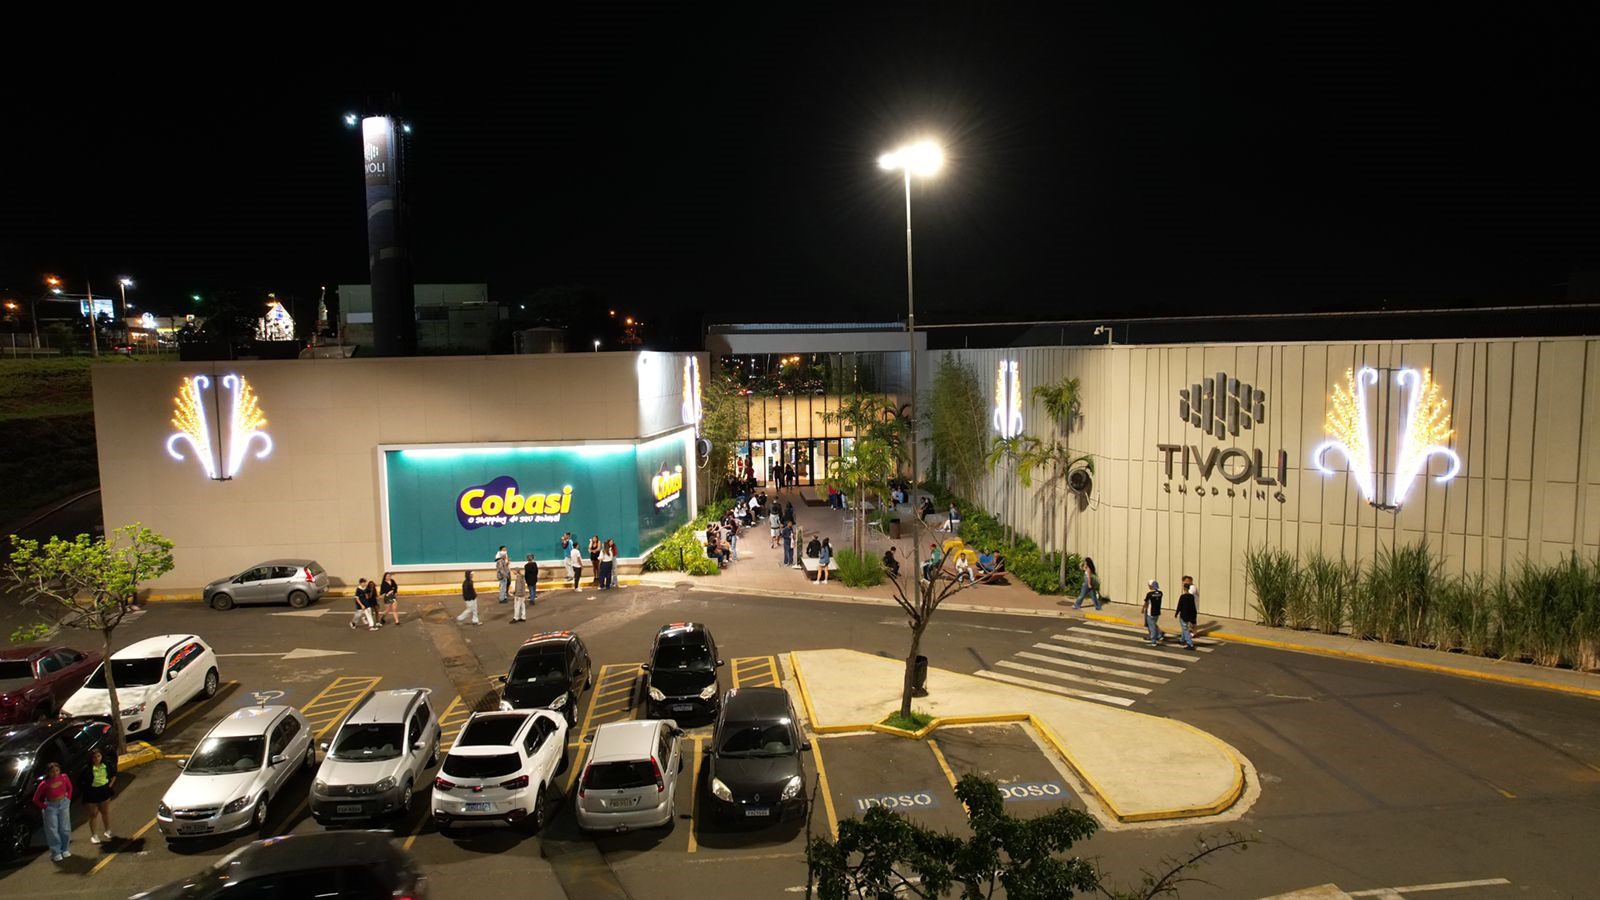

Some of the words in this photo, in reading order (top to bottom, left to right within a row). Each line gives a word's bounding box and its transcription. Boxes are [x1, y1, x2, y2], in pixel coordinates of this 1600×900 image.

[1157, 444, 1288, 487] TIVOLI
[460, 485, 573, 516] Cobasi
[1163, 483, 1287, 504] SHOPPING
[858, 793, 932, 810] IDOSO
[1000, 784, 1061, 799] DOSO
